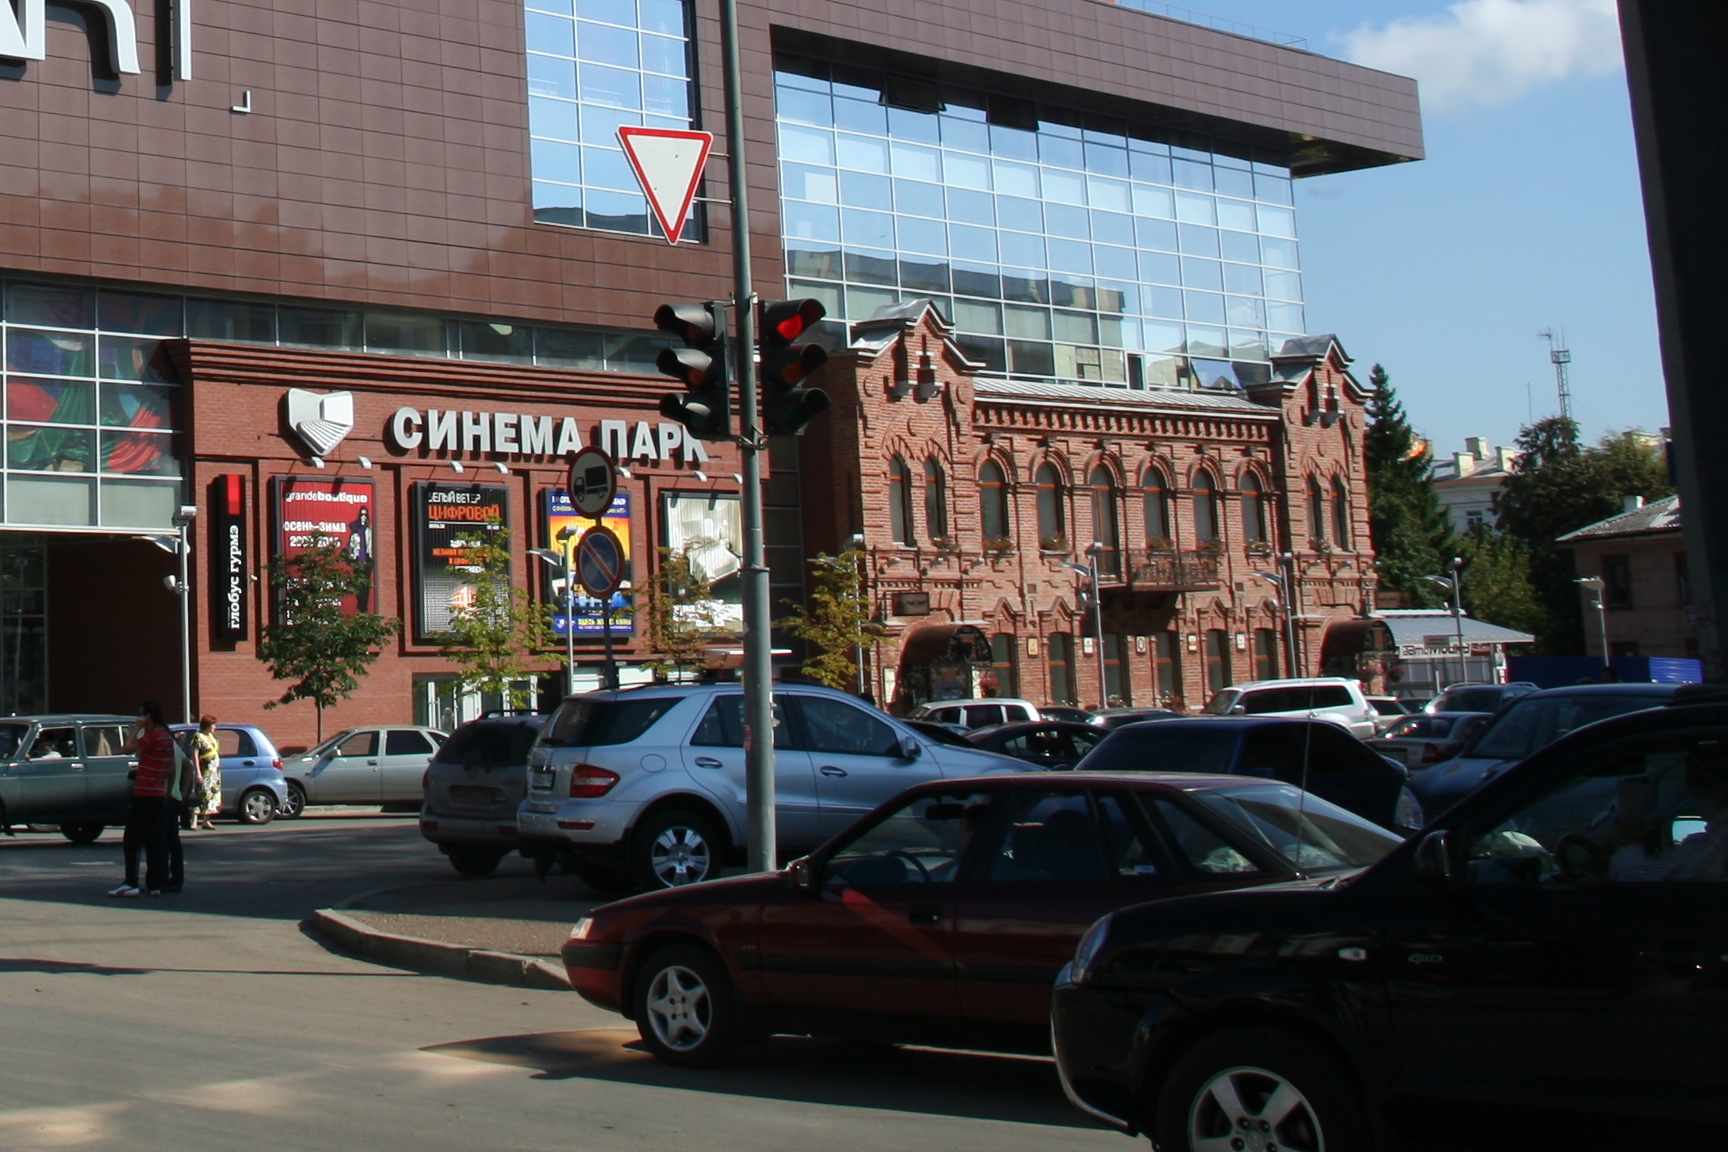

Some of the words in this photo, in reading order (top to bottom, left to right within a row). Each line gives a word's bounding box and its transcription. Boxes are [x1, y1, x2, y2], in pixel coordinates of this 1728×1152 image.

[393, 406, 583, 455] СИНЕМА
[600, 419, 709, 462] ПАРК
[428, 504, 500, 521] ЦИФРОВОЙ
[229, 525, 242, 573] гурмэ
[227, 576, 242, 629] глобус
